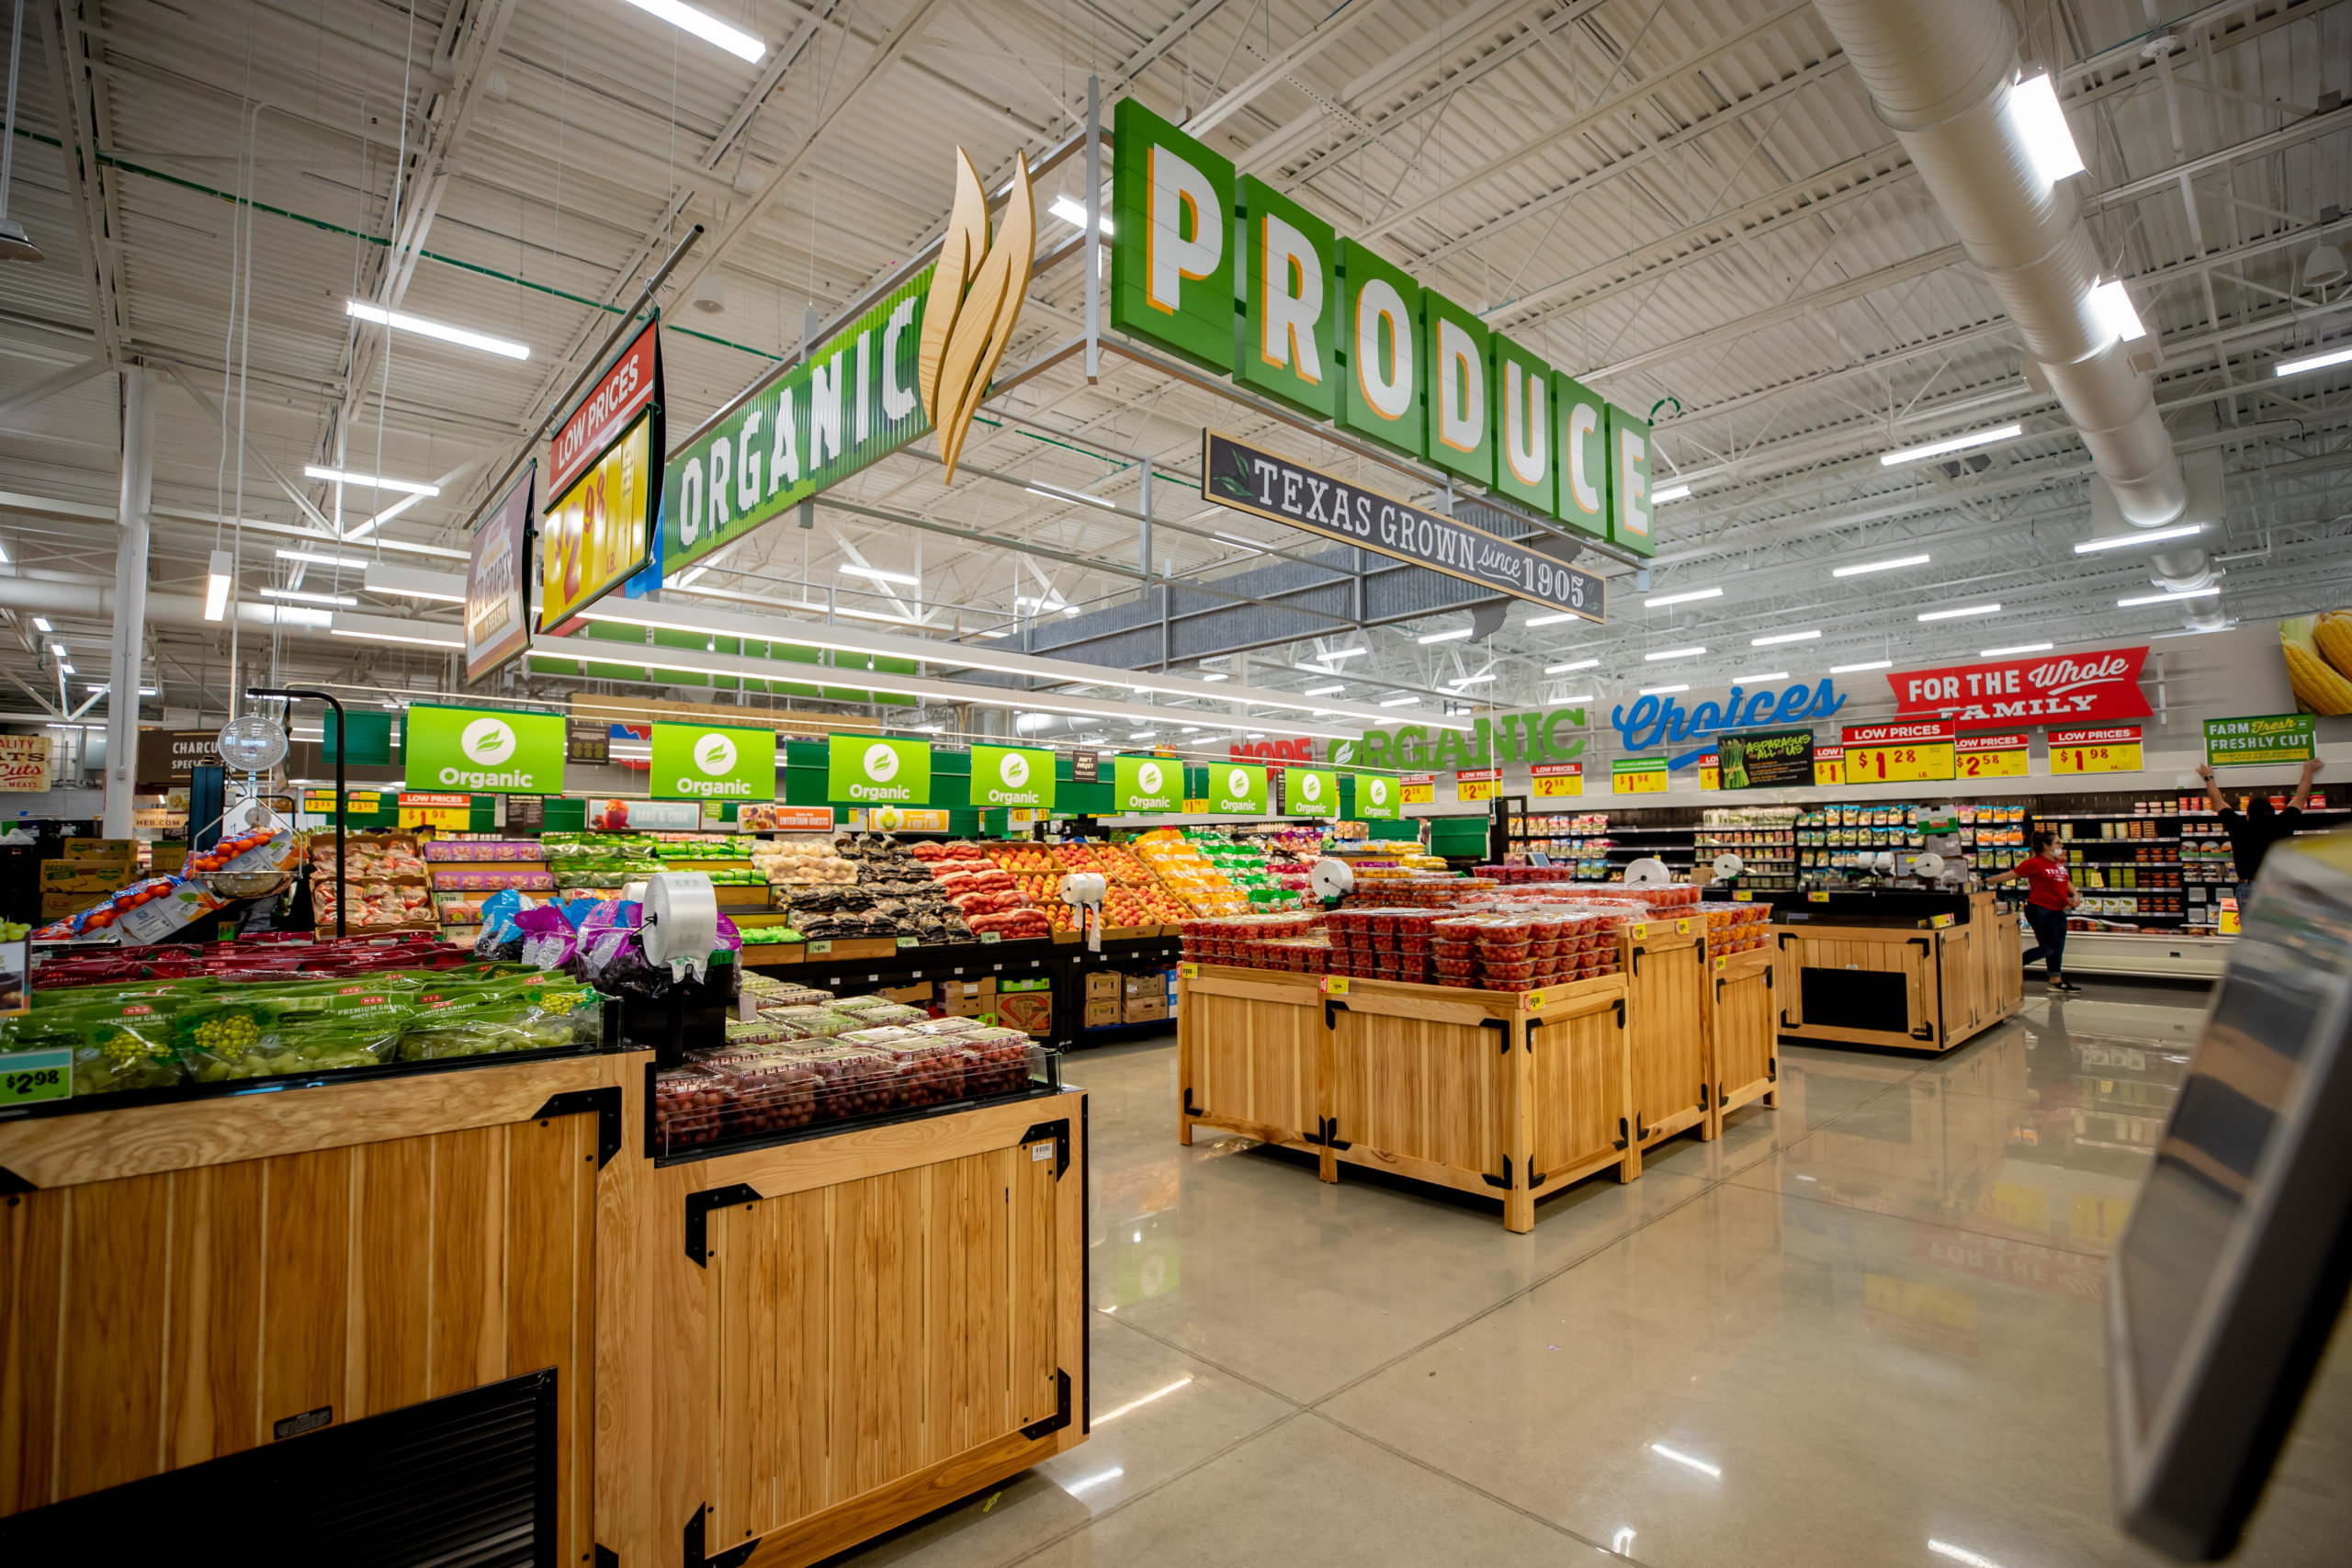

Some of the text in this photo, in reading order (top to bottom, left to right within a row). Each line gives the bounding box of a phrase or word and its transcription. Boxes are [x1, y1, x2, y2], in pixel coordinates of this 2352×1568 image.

[1147, 142, 1649, 537] PRODUCE
[559, 355, 639, 470] LOW PRICES
[680, 296, 917, 547] ORGANIC
[1254, 457, 1586, 609] TEXAS GROWN since 1905
[606, 551, 617, 575] LB.
[486, 549, 510, 608] GRAPES
[1908, 655, 2130, 702] FOR THE Whole
[1611, 678, 1847, 751] Choices
[1854, 724, 1941, 740] LOW PRICES
[2209, 722, 2249, 735] FARM
[2251, 717, 2297, 734] Fresh
[1327, 706, 1588, 773] ORGANIC
[1956, 737, 2018, 748] LOW PRICES
[2058, 729, 2131, 741] LOW PRICES
[2211, 734, 2309, 750] FRESHLY CUT
[1746, 734, 1811, 755] ASPARAGUS
[1757, 749, 1777, 761] ALL
[1786, 744, 1804, 755] US
[1817, 748, 1838, 756] LOW
[0, 762, 42, 778] Cuts
[439, 767, 534, 789] Organic
[677, 777, 752, 796] Organic
[849, 784, 910, 801] Organic
[407, 795, 463, 804] LOW PRICES
[989, 789, 1039, 805] Organic
[1129, 795, 1171, 809] Organic
[1220, 799, 1256, 811] Organic
[1295, 802, 1327, 814] Organic
[1364, 806, 1392, 818] Organic
[779, 817, 830, 826] ENTERTAIN GUESTS
[338, 1005, 377, 1015] PREMIUM
[447, 1002, 476, 1010] GRAPES
[6, 1069, 60, 1095] $298
